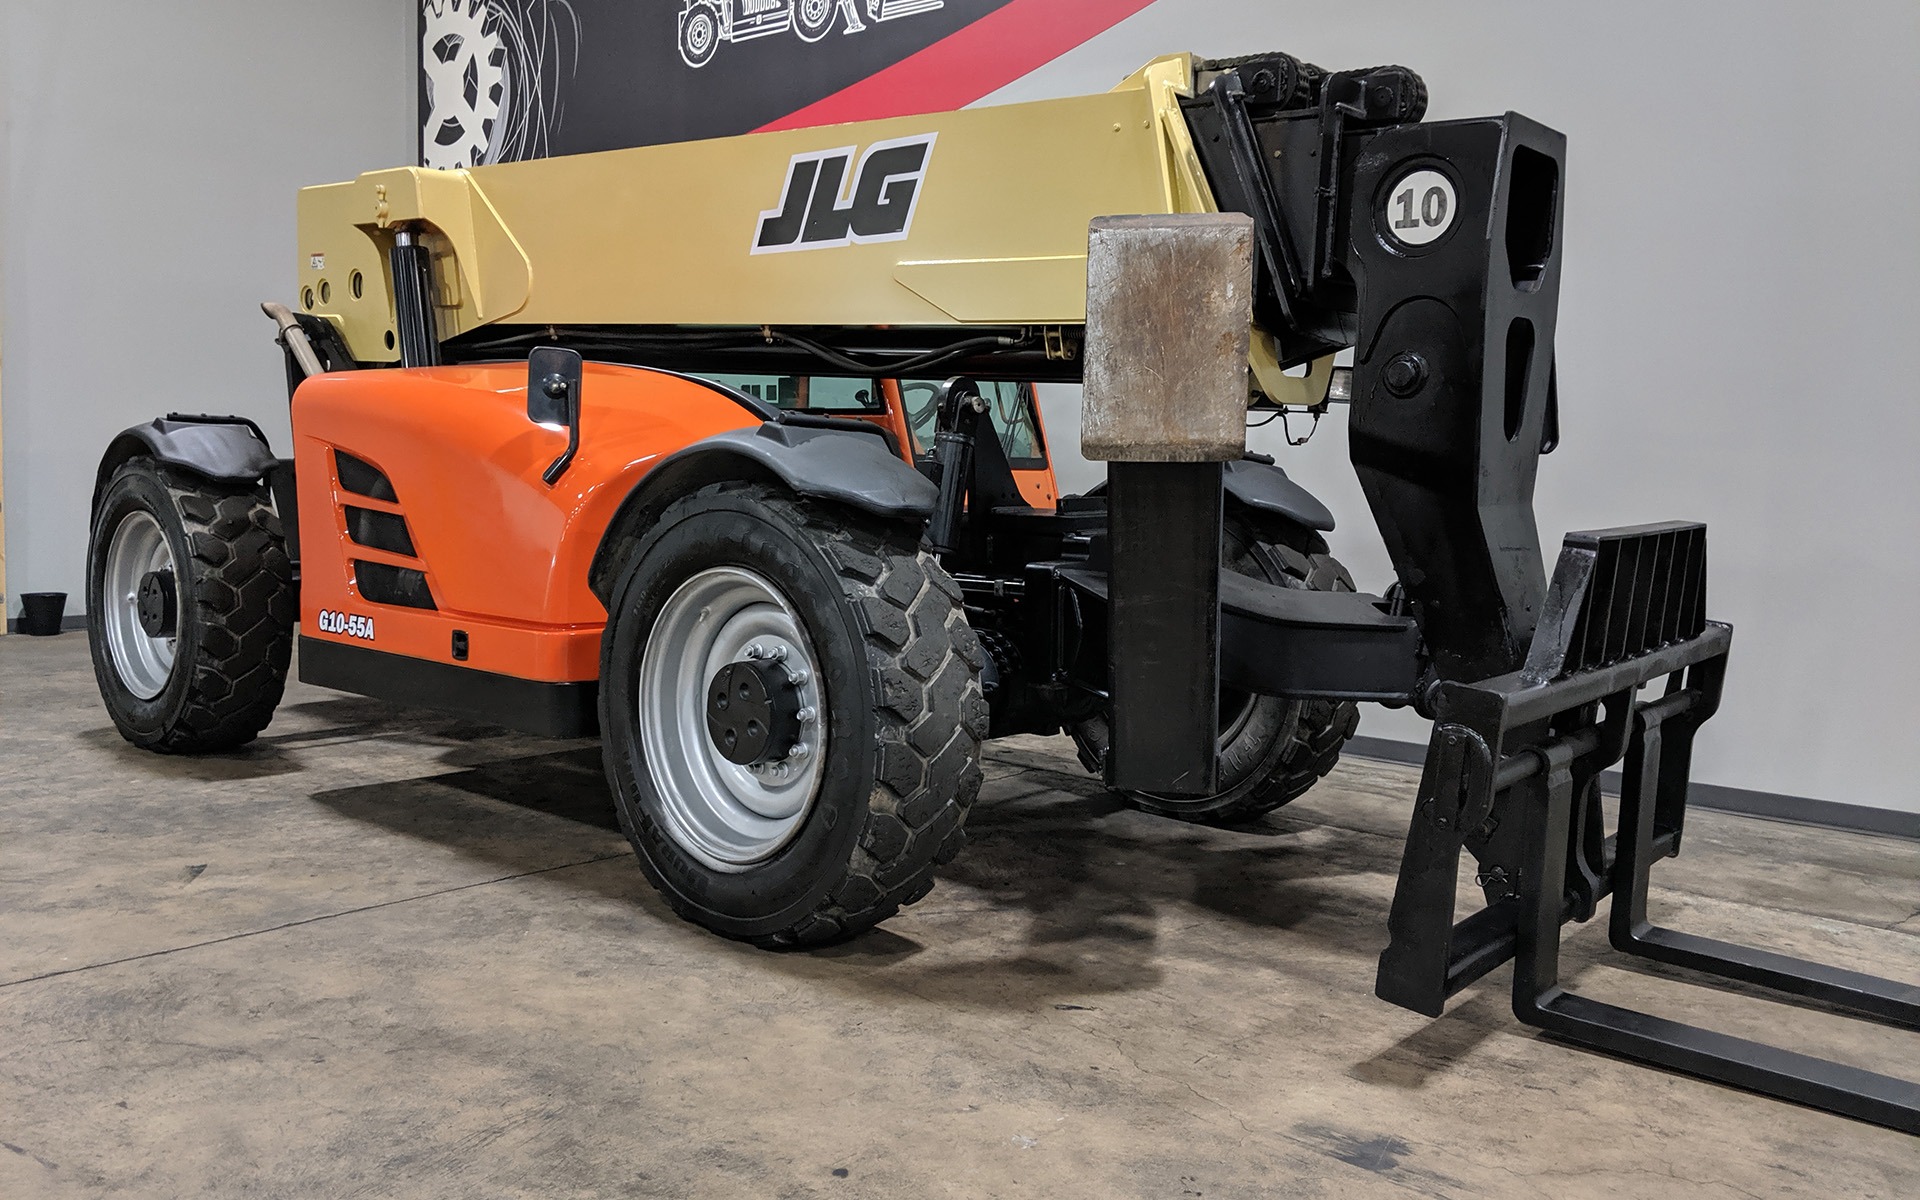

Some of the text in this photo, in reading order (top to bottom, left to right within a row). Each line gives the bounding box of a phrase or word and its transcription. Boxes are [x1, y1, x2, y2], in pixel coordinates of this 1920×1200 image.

[756, 141, 930, 248] JLG
[1395, 186, 1448, 229] 10
[318, 609, 375, 641] G10-55A
